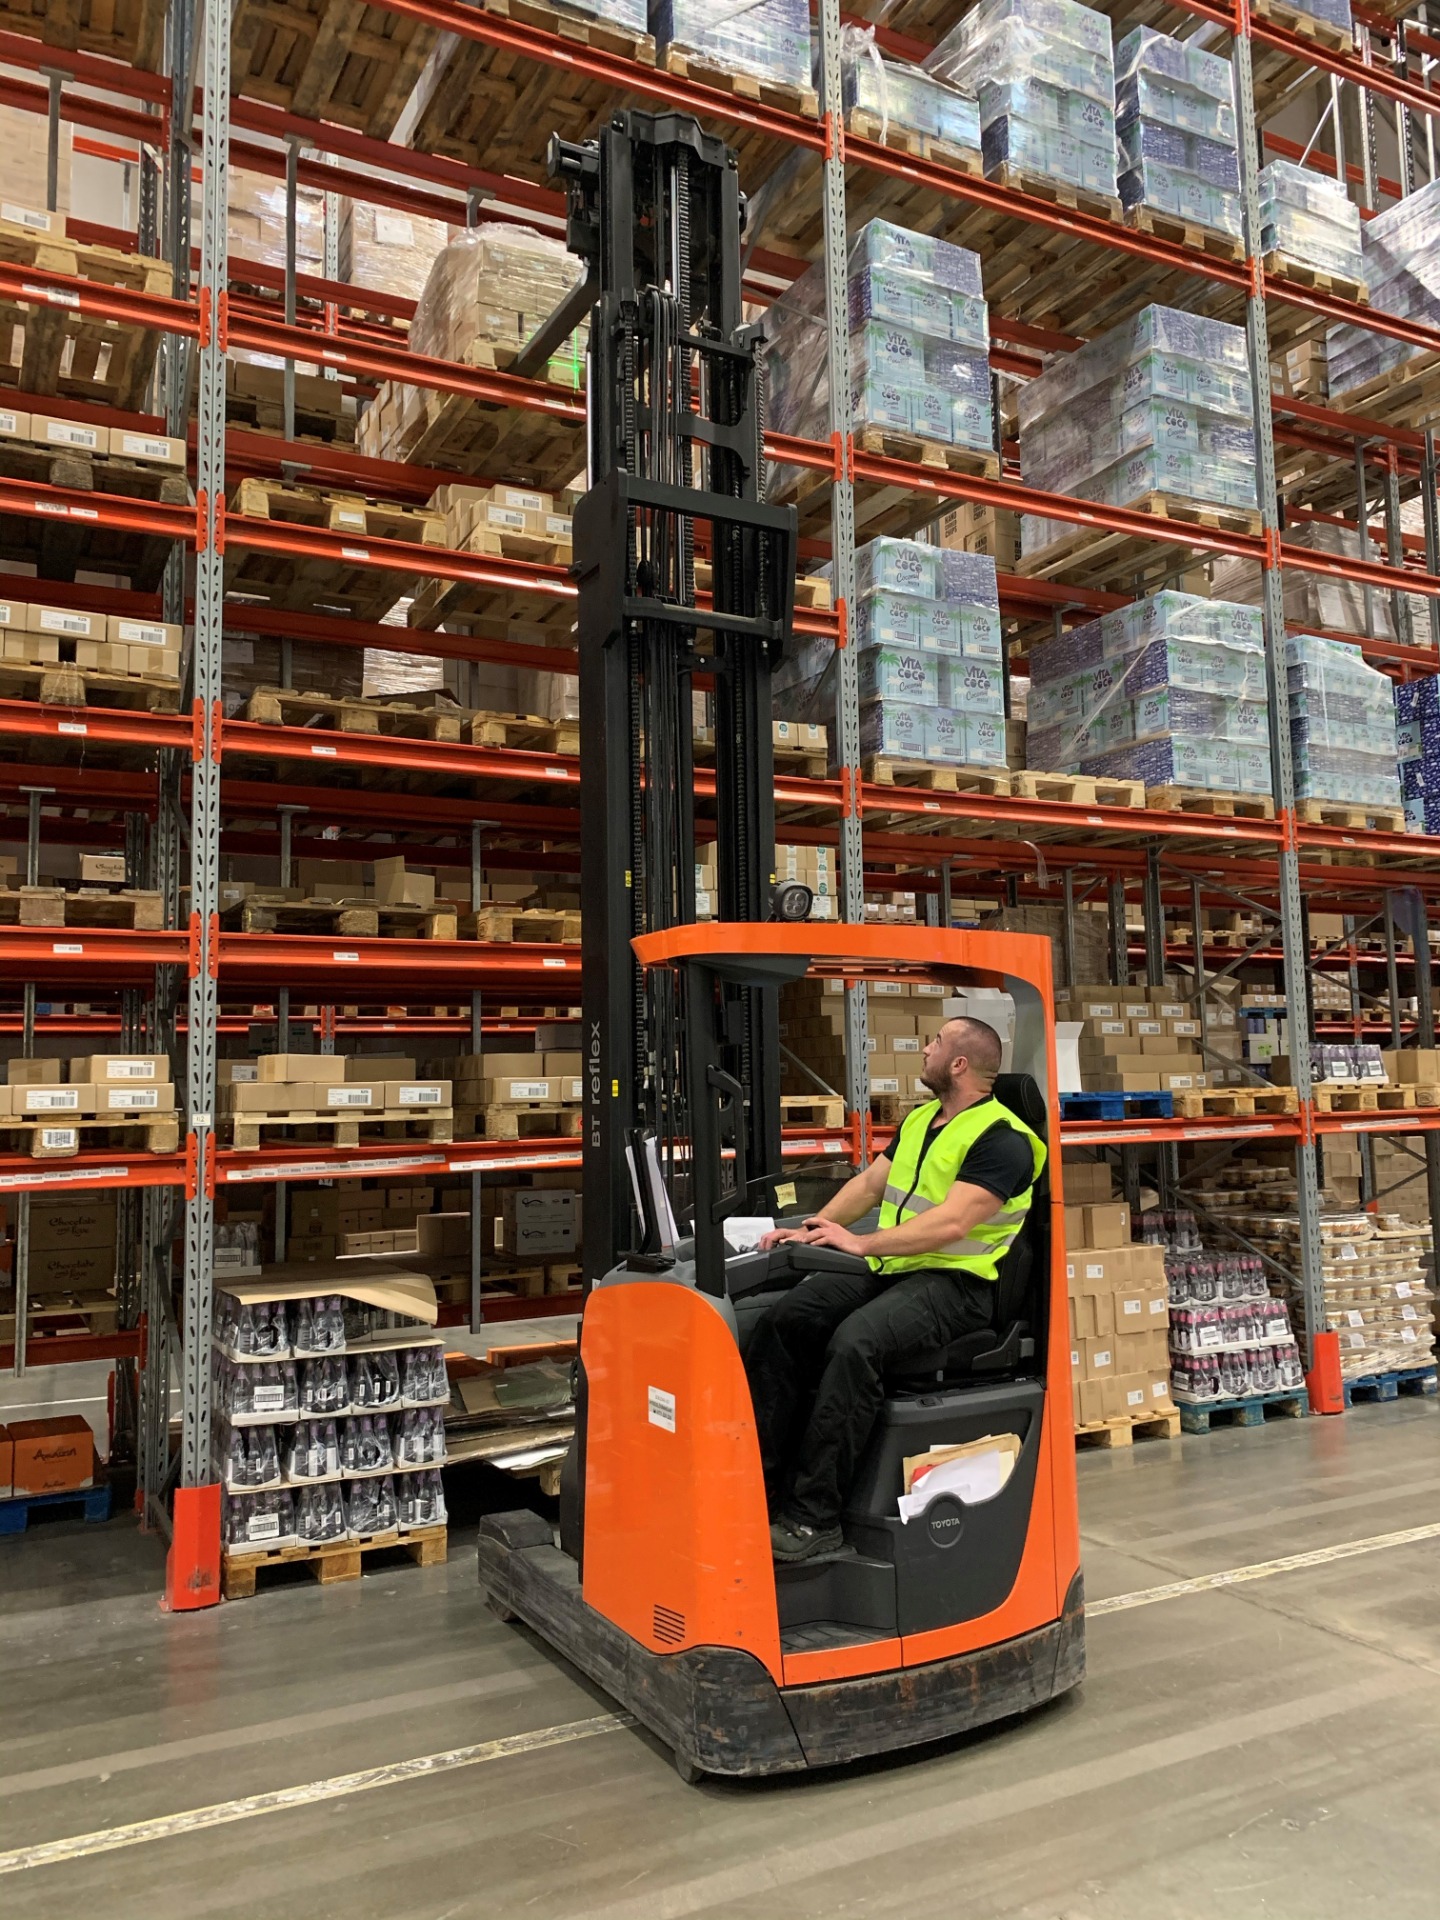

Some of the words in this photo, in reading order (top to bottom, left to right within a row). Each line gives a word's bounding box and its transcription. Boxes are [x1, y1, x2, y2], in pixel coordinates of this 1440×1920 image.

[1082, 102, 1102, 118] VITA
[1082, 113, 1105, 127] COCO
[887, 331, 909, 347] VITA
[885, 343, 913, 358] COCO
[882, 391, 900, 401] COCO
[924, 401, 942, 411] COCO
[964, 412, 981, 421] COCO
[1167, 406, 1185, 420] VITA
[1165, 416, 1189, 429] COCO
[1127, 460, 1144, 473] VITA
[944, 511, 957, 525] HAND
[973, 508, 987, 521] CHIPS
[945, 526, 957, 539] CHIPS
[974, 536, 987, 549] HAND
[897, 547, 919, 563] VITA
[895, 559, 923, 573] COCO
[891, 601, 907, 611] VITA
[889, 609, 909, 619] COCO
[933, 609, 949, 619] VITA
[1232, 609, 1249, 621] VITA
[932, 617, 950, 625] COCO
[974, 616, 989, 625] VITA
[1231, 620, 1253, 630] COCO
[972, 624, 991, 632] COCO
[900, 655, 922, 671] VITA
[1178, 656, 1193, 664] COCO
[898, 668, 926, 681] COCO
[965, 665, 988, 679] VITA
[1093, 668, 1110, 681] VITA
[963, 677, 991, 689] COCO
[1092, 677, 1113, 691] COCO
[1062, 684, 1072, 693] VITA
[1060, 690, 1074, 699] COCO
[1145, 701, 1157, 709] VITA
[1239, 703, 1255, 716] VITA
[896, 712, 912, 721] VITA
[1144, 707, 1159, 717] COCO
[937, 717, 953, 726] VITA
[1111, 714, 1122, 722] VITA
[1237, 714, 1259, 724] COCO
[895, 720, 914, 729] COCO
[936, 725, 955, 733] COCO
[978, 721, 993, 730] VITA
[1110, 720, 1124, 729] COCO
[978, 729, 996, 737] COCO
[1398, 732, 1410, 740] VITA
[1184, 746, 1195, 754] VITA
[589, 1021, 600, 1105] reflex
[591, 1114, 601, 1148] BT
[49, 1216, 97, 1227] Chocolate
[47, 1260, 95, 1271] Chocolate
[931, 1517, 960, 1530] TOYOTA
